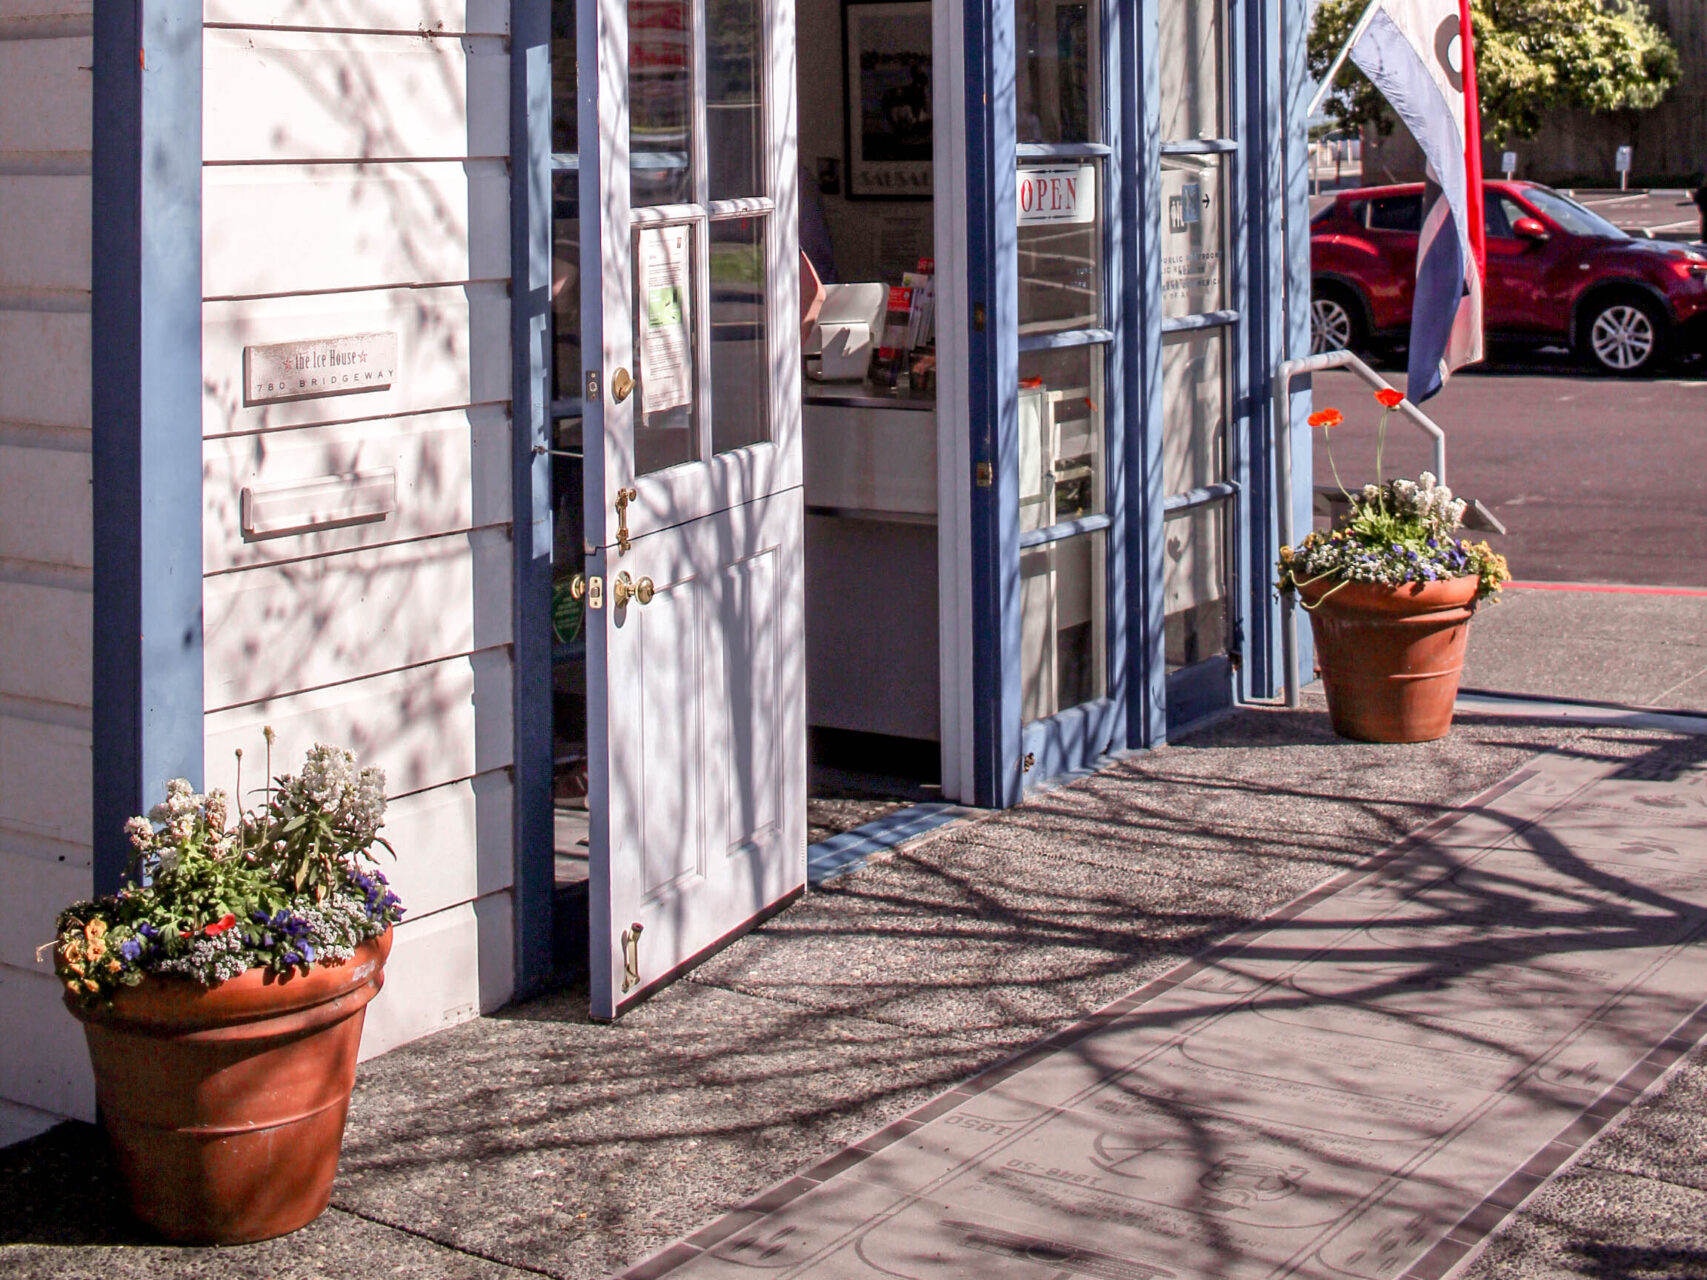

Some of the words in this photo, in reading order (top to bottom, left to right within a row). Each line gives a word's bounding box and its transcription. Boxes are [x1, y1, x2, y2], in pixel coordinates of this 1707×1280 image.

[1021, 177, 1078, 213] OPEN
[295, 353, 310, 370] the
[313, 351, 326, 369] Ice
[330, 349, 357, 367] House
[257, 382, 286, 393] 780
[299, 370, 394, 388] BRIDGEWAY
[944, 1115, 1012, 1136] 1850
[1005, 1158, 1103, 1186] 1848-50
